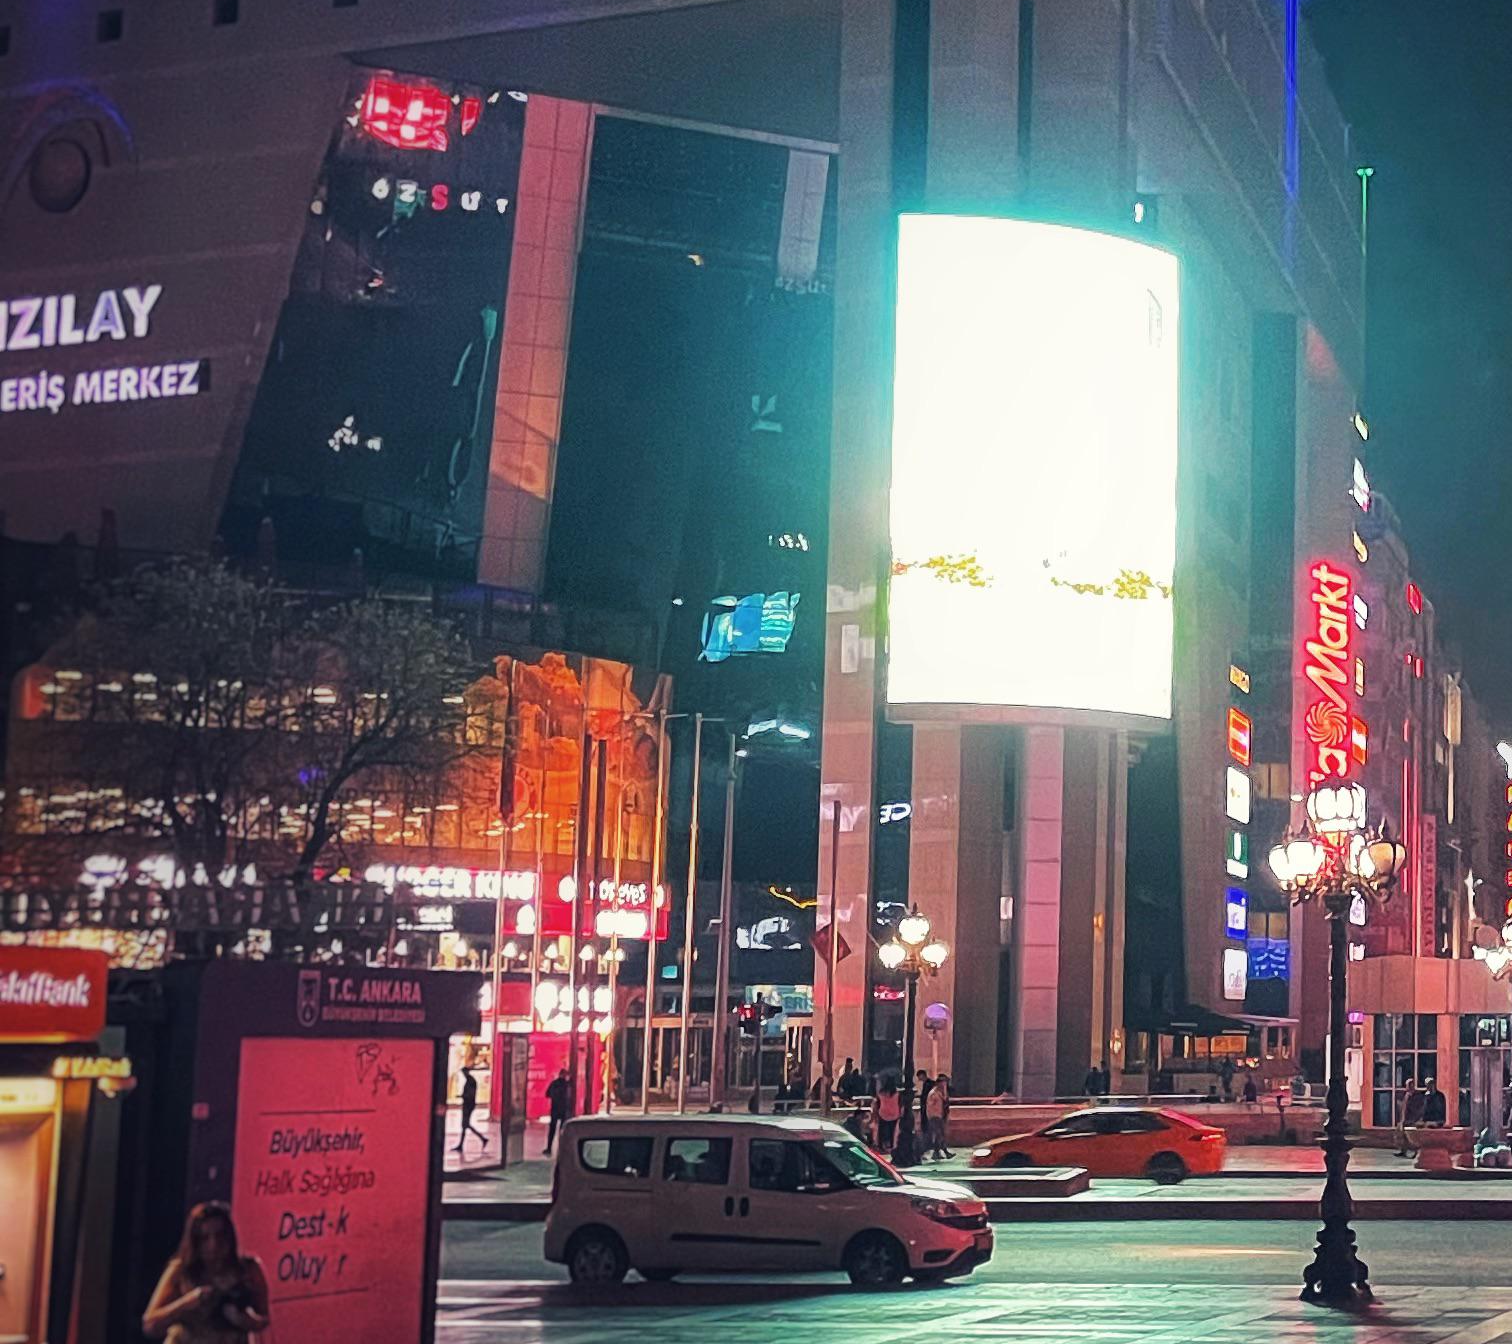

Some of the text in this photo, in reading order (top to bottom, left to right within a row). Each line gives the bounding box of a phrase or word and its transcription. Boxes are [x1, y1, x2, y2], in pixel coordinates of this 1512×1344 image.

[361, 979, 423, 1005] ANKARA
[254, 1169, 295, 1197] Halk
[278, 1207, 350, 1241] Destk
[277, 1250, 348, 1285] Oluyr
